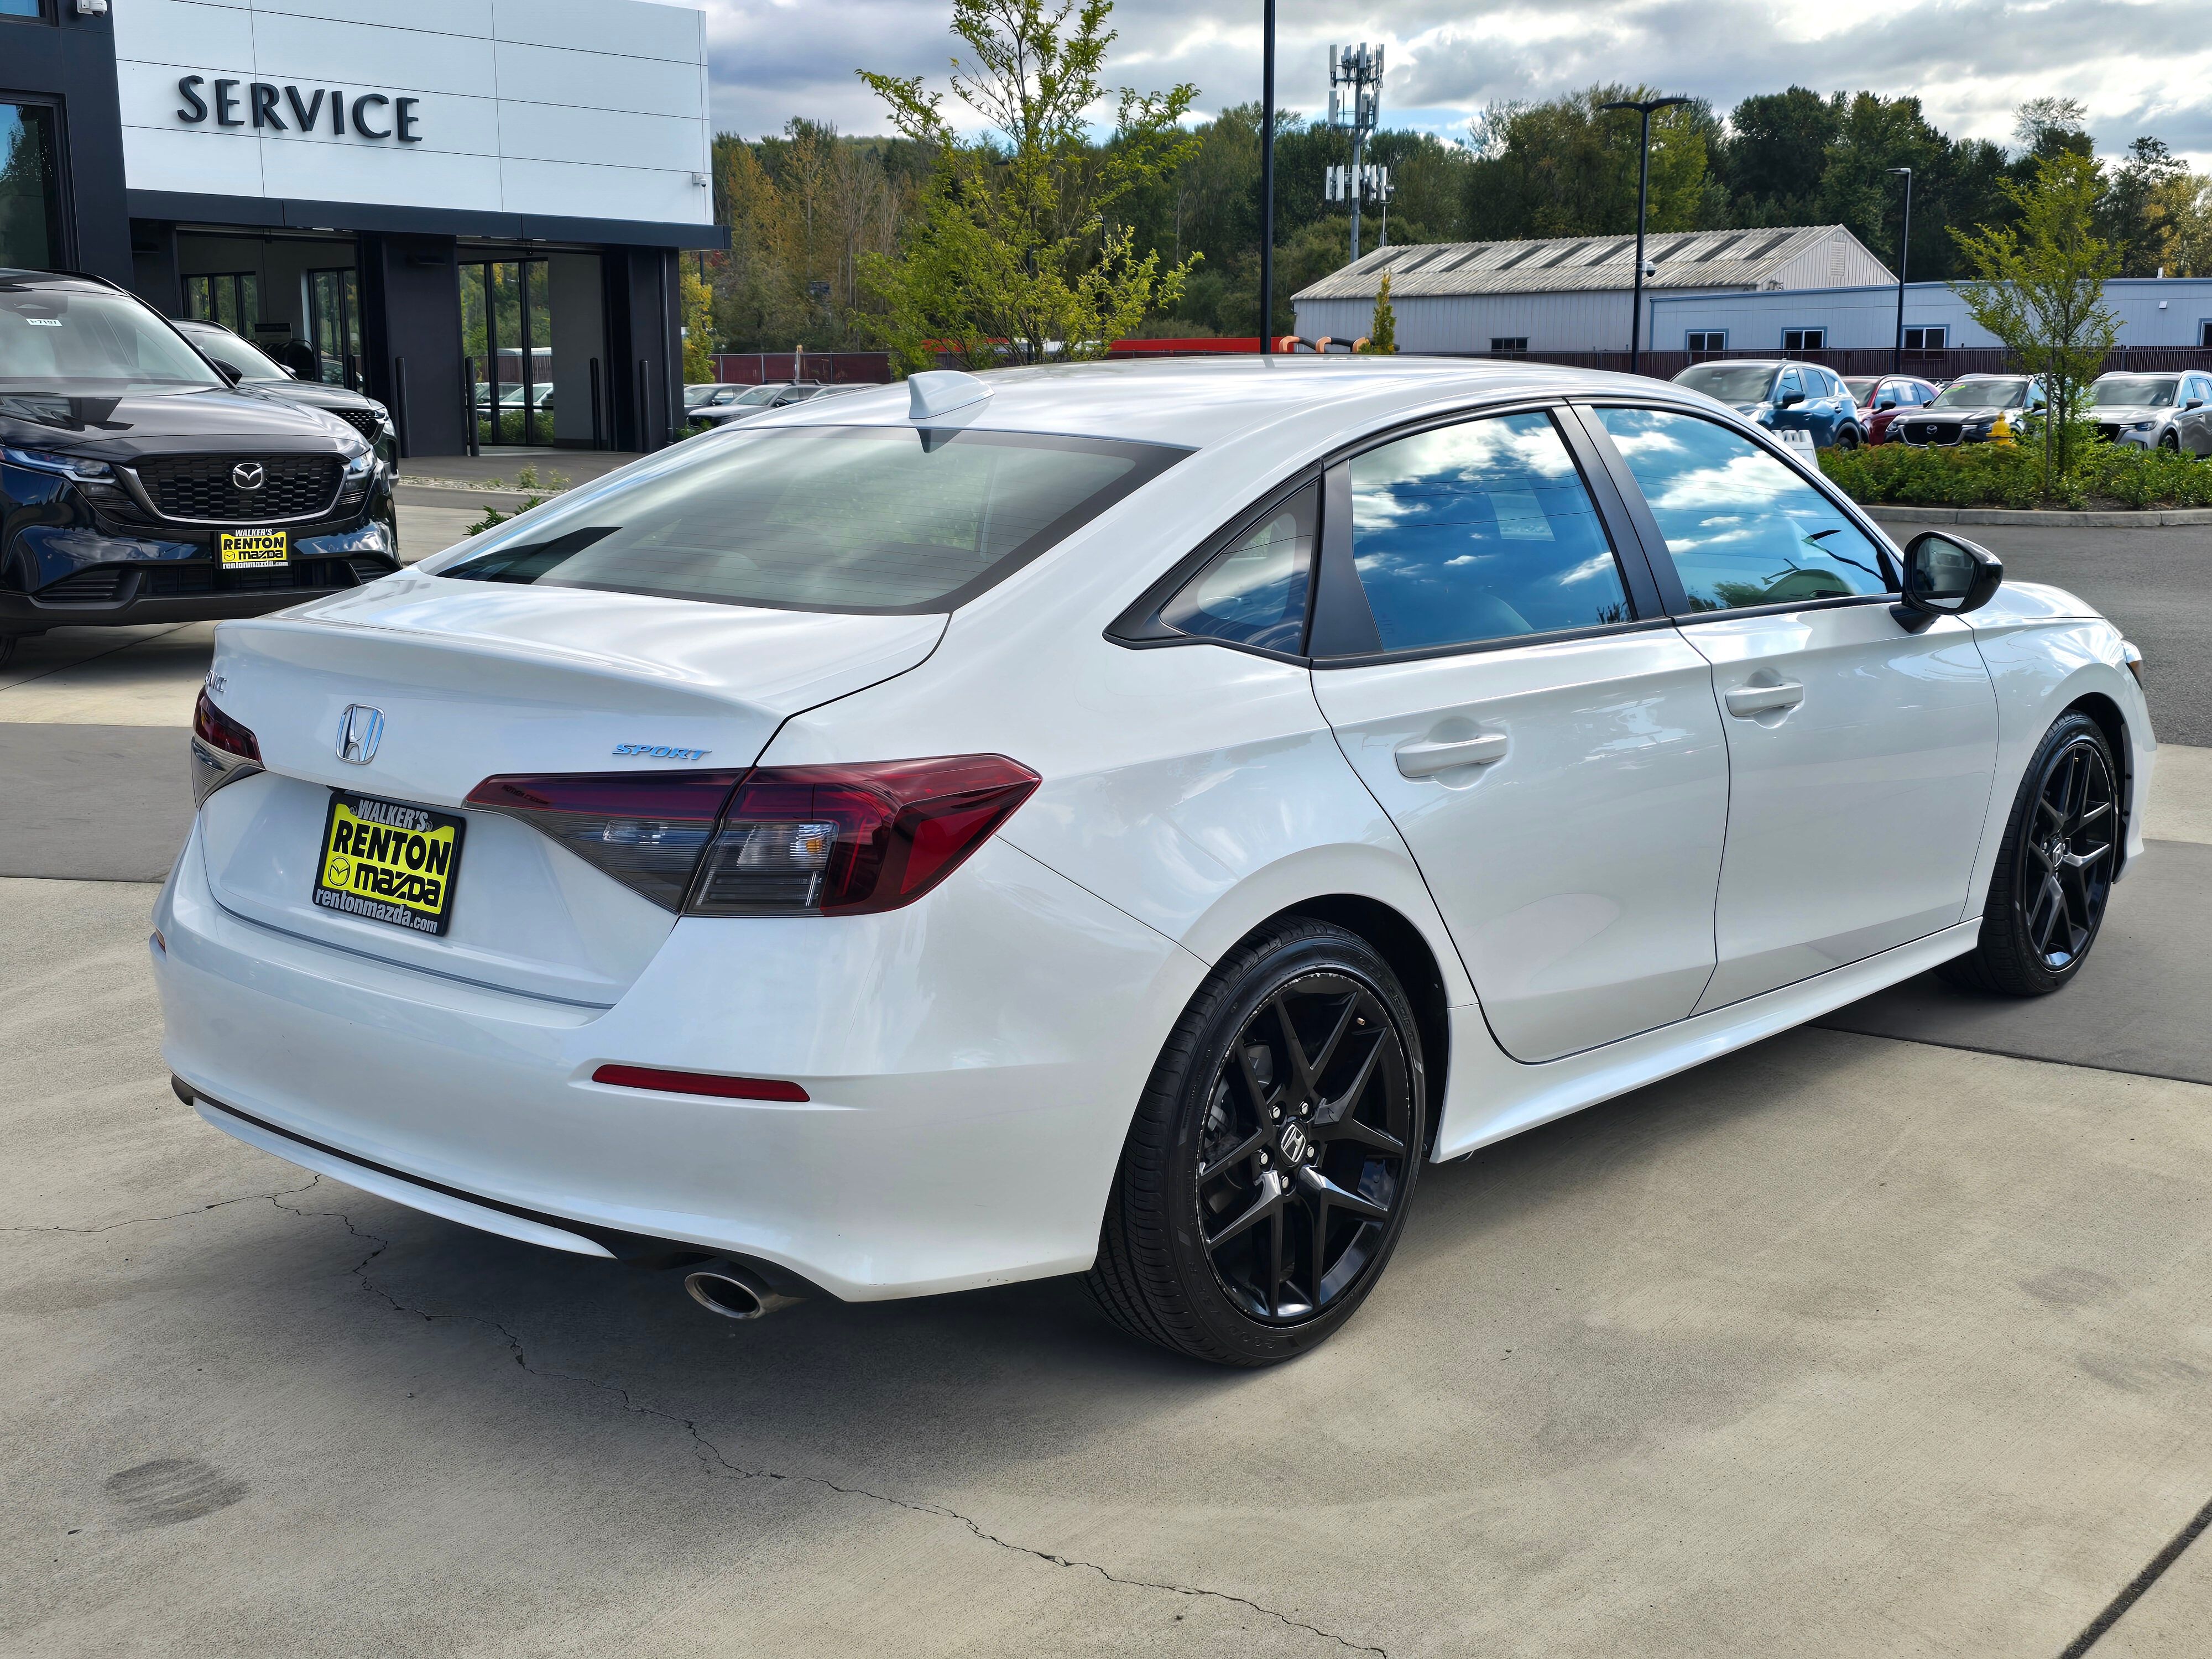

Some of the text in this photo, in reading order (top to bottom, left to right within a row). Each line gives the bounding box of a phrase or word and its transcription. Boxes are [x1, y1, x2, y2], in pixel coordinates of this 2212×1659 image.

[177, 75, 423, 142] SERVICE
[223, 537, 284, 550] RENTON
[235, 529, 273, 537] WALKER'S
[222, 560, 288, 569] rentonmazda.com
[238, 550, 283, 560] mazda
[612, 743, 712, 760] SPORT
[357, 799, 429, 832] WALKER'S
[332, 820, 452, 877] RENTON
[353, 862, 441, 907] mazda
[315, 889, 438, 933] rentonmazda.com
